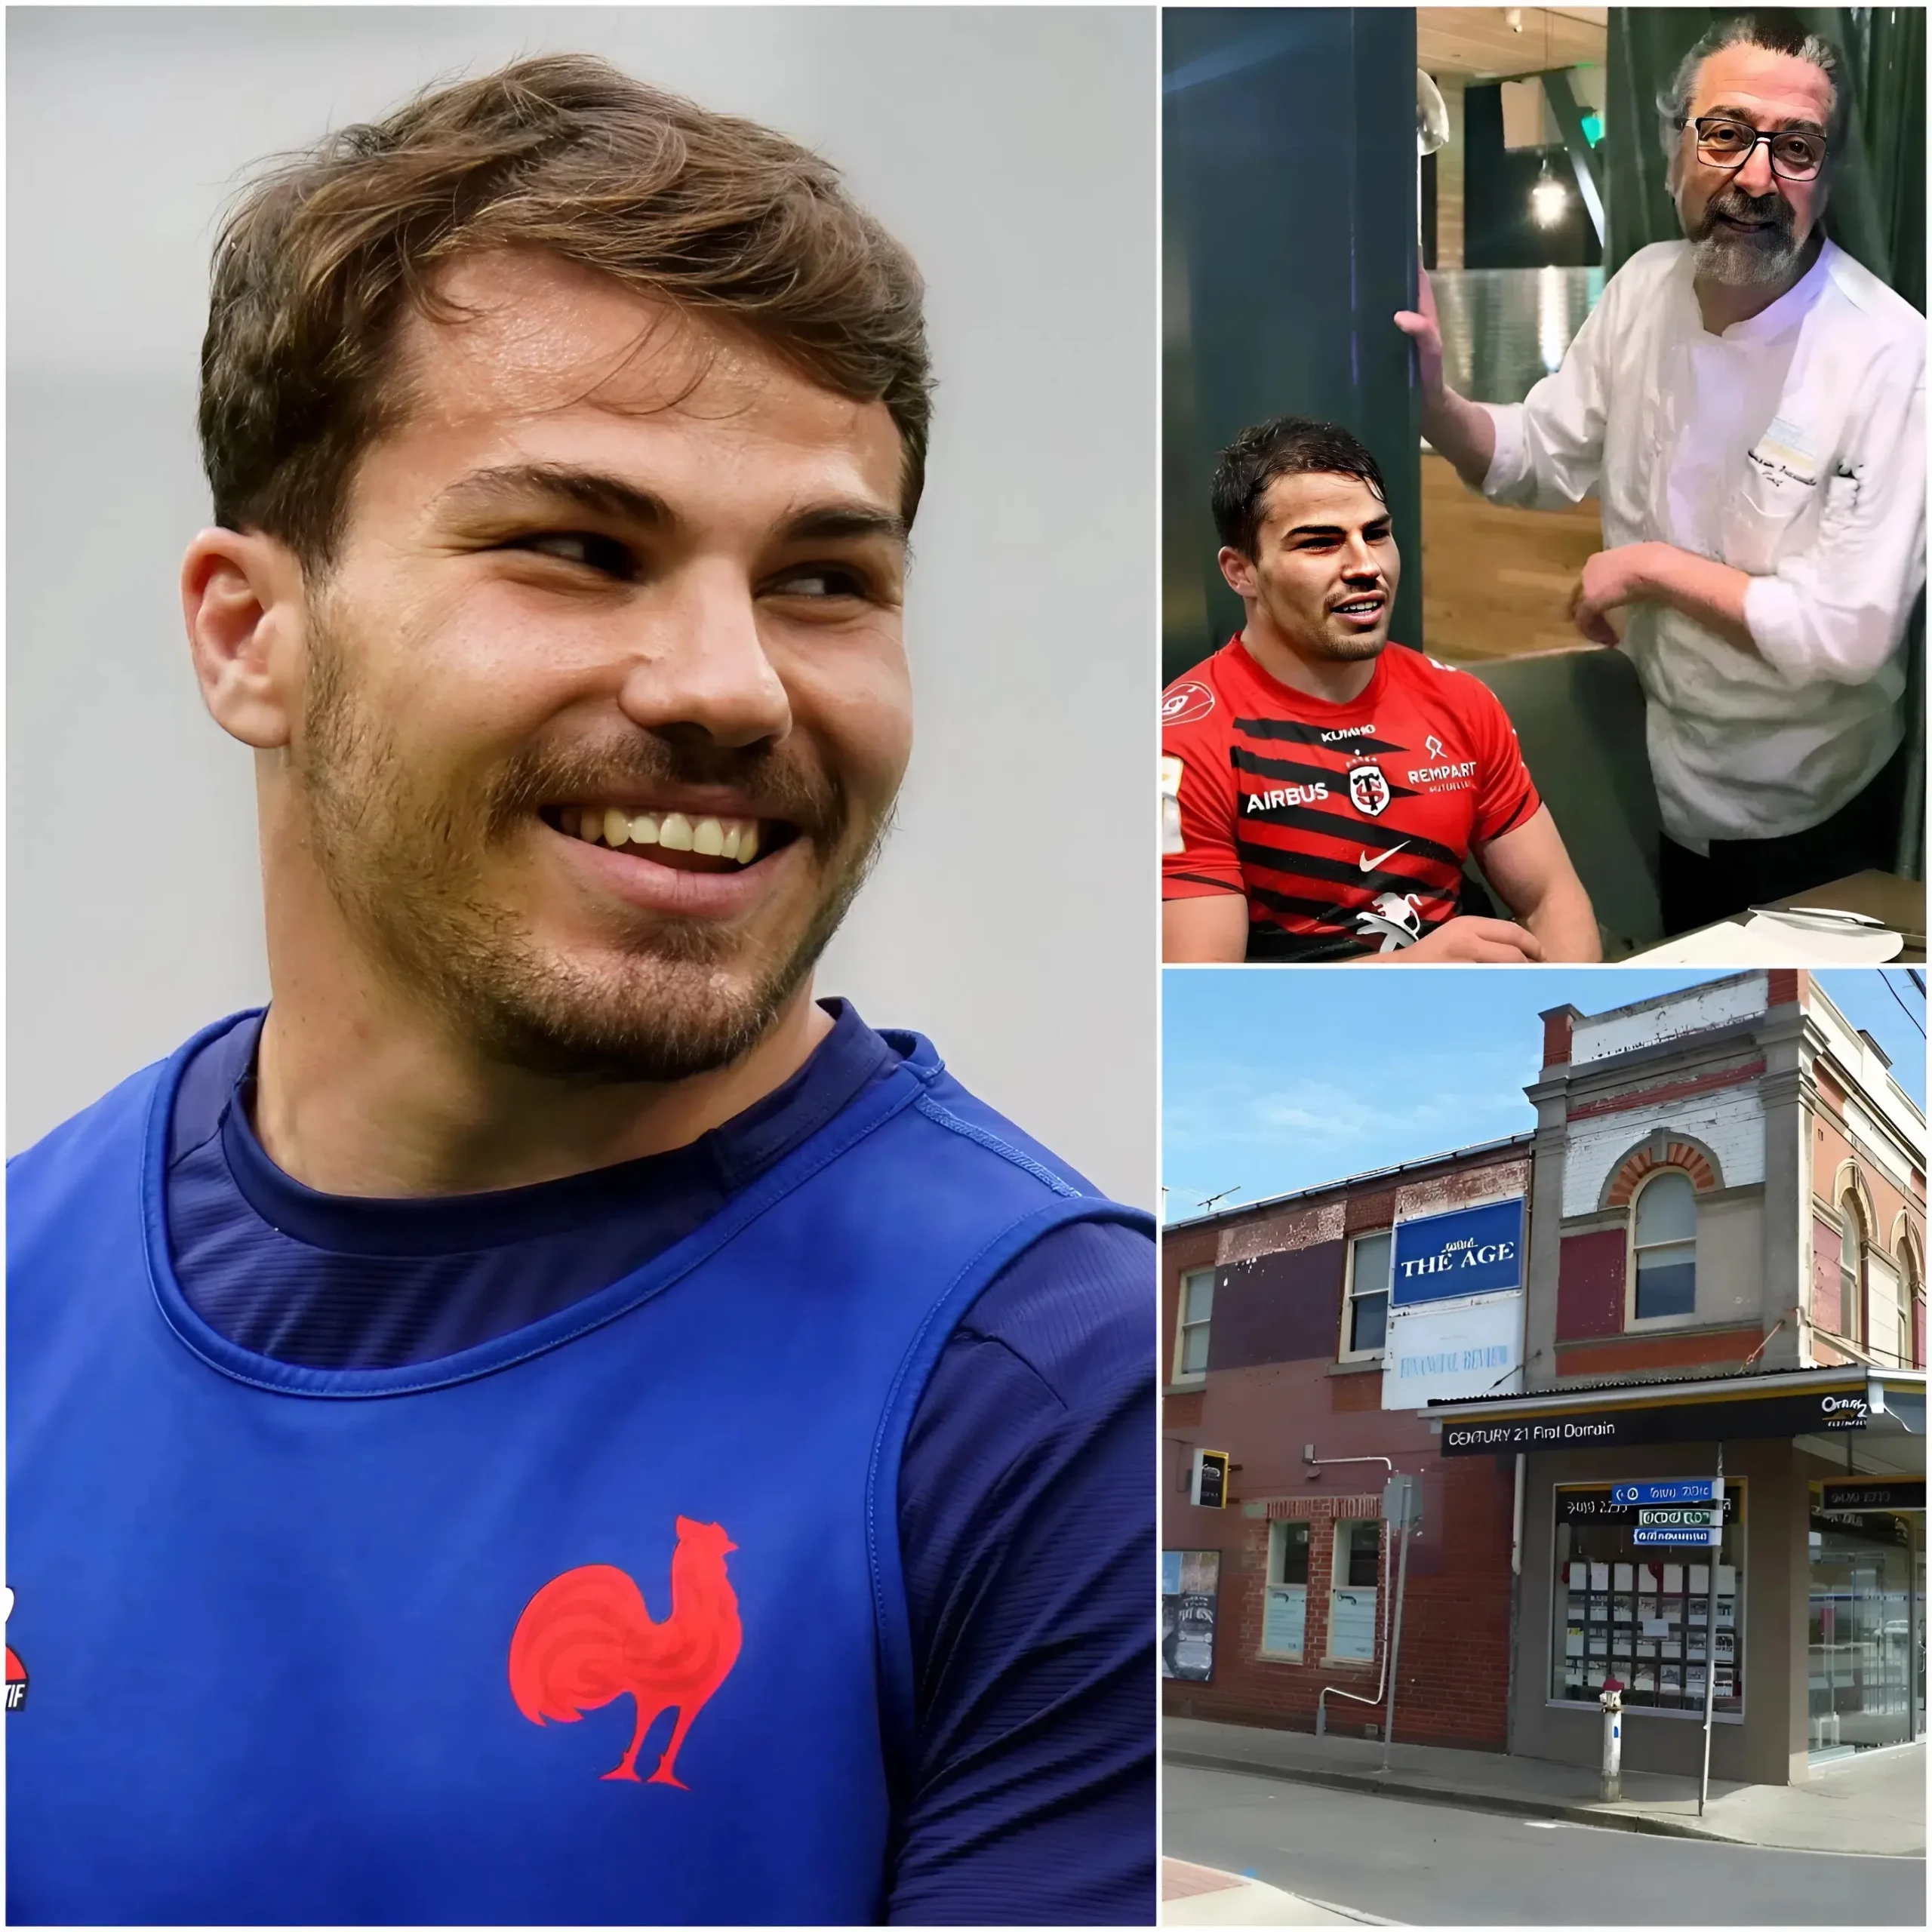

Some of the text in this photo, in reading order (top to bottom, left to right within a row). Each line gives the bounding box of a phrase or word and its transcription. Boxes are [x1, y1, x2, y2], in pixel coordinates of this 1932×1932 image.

[1407, 761, 1476, 784] REMPART
[1247, 783, 1328, 813] AIRBUS
[1401, 1253, 1453, 1277] THE
[1461, 1241, 1515, 1269] AGE
[1514, 1427, 1528, 1441] 21
